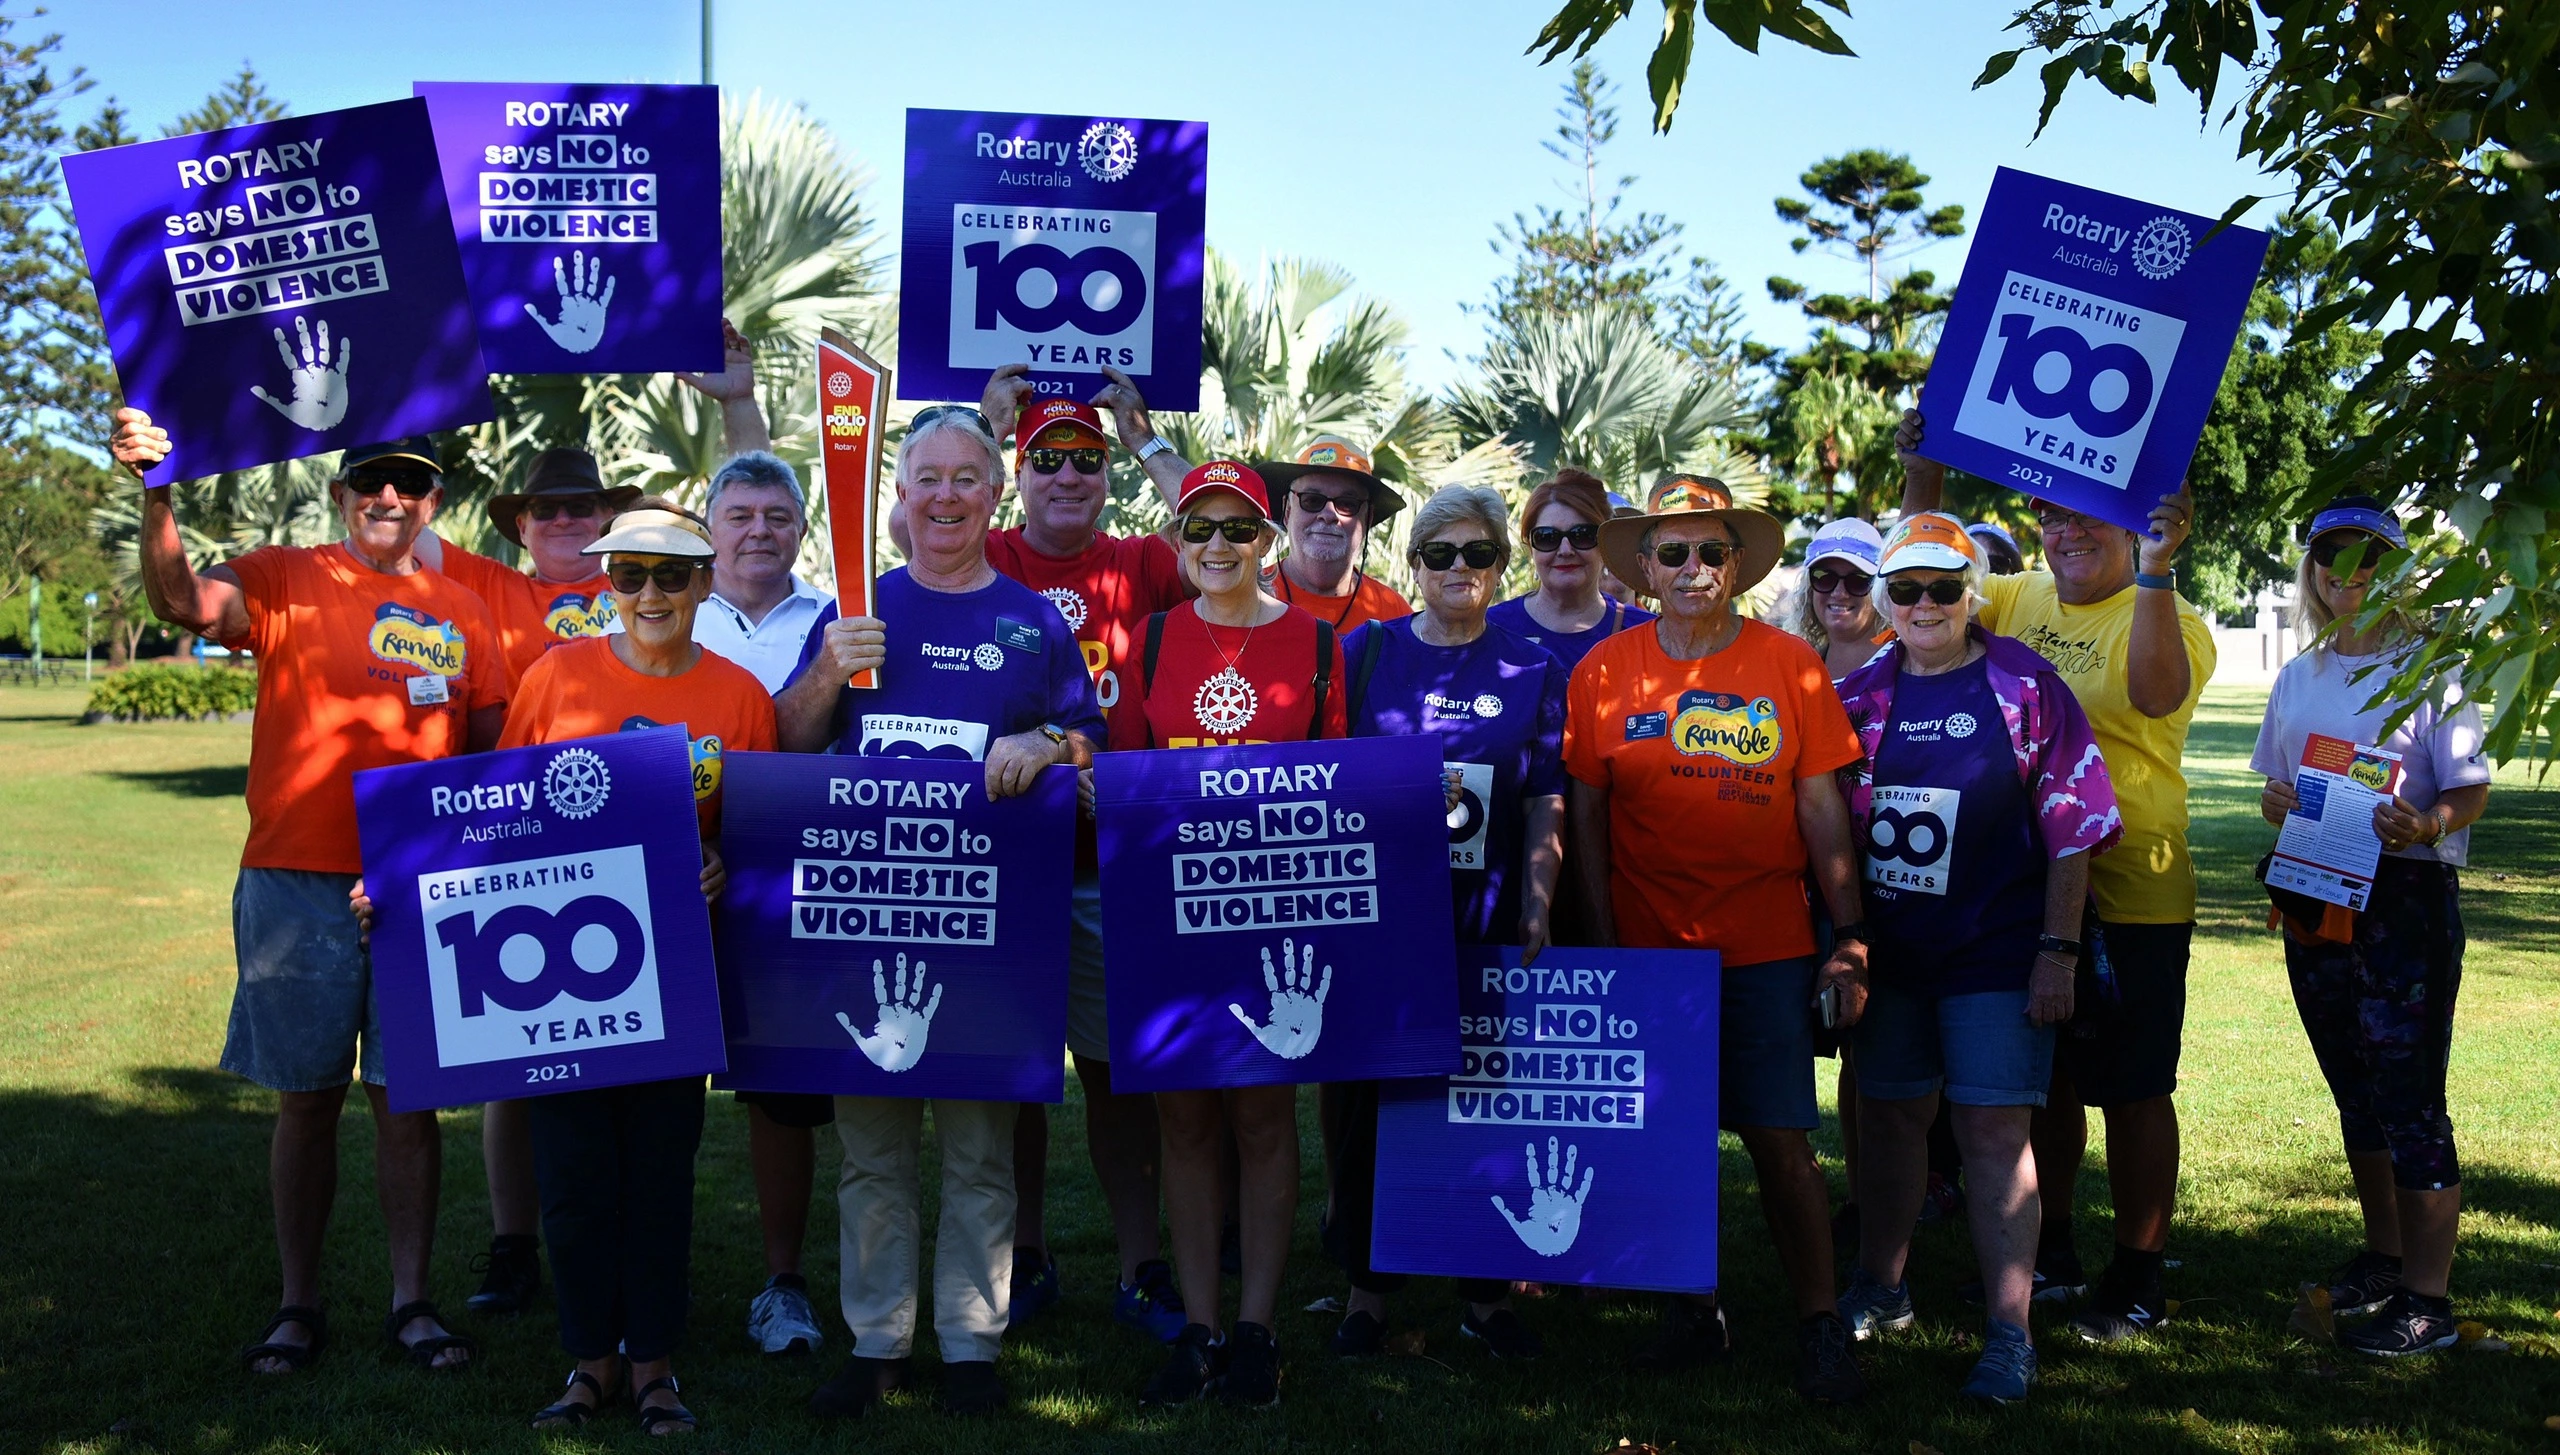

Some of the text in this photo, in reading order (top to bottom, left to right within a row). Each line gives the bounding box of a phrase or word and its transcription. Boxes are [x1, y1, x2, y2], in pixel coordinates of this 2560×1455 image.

[505, 101, 629, 128] ROTARY
[484, 138, 649, 169] says NO to
[976, 132, 1071, 166] Rotary
[176, 138, 324, 189] ROTARY
[488, 178, 650, 202] DOMESTIC
[998, 169, 1072, 188] Australia
[165, 180, 360, 237] says NO to
[488, 214, 651, 238] VIOLENCE
[961, 212, 1112, 234] CELEBRATING
[2042, 203, 2130, 254] Rotary
[175, 222, 371, 278] DOMESTIC
[2052, 245, 2119, 276] Australia
[182, 261, 381, 320] VIOLENCE
[963, 240, 1147, 336] 100
[2008, 281, 2141, 332] CELEBRATING
[1027, 343, 1135, 367] YEARS
[1986, 313, 2154, 439] 100
[826, 415, 866, 426] POLIO
[833, 405, 861, 416] END
[1043, 405, 1077, 415] POLIO
[830, 425, 862, 436] NOW
[834, 443, 857, 452] Rotary
[2023, 427, 2117, 474] YEARS
[1204, 469, 1240, 479] POLIO
[2008, 463, 2053, 488] 2021
[390, 607, 412, 618] Rotary
[382, 632, 459, 669] Ramble
[921, 642, 971, 660] Rotary
[931, 660, 970, 671] Australia
[1424, 693, 1471, 711] Rotary
[1433, 710, 1470, 720] Australia
[1691, 697, 1714, 705] Rotary
[1756, 700, 1771, 713] R
[864, 719, 959, 736] CELEBRATING
[1899, 717, 1943, 733] Rotary
[1906, 733, 1941, 742] Australia
[1685, 724, 1771, 755] Ramble
[1199, 763, 1339, 797] ROTARY
[1670, 765, 1775, 785] VOLUNTEER
[2352, 768, 2385, 786] Ramble
[431, 781, 536, 816] Rotary
[828, 777, 971, 809] ROTARY
[1872, 791, 1931, 802] EBRATING
[461, 817, 542, 844] Australia
[802, 822, 992, 856] says NO to
[1178, 805, 1366, 847] says NO to
[1867, 806, 1948, 868] 00
[429, 862, 595, 900] CELEBRATING
[1181, 848, 1368, 886] DOMESTIC
[1875, 866, 1935, 888] YEARS
[801, 865, 991, 899] DOMESTIC
[1873, 887, 1897, 900] 2021
[799, 906, 988, 940] VIOLENCE
[1182, 890, 1371, 928] VIOLENCE
[435, 894, 646, 1019] 100
[1482, 967, 1617, 995] ROTARY
[521, 1011, 643, 1046] YEARS
[1459, 1008, 1638, 1042] says NO to
[526, 1062, 581, 1083] 2021
[1457, 1051, 1638, 1083] DOMESTIC
[1455, 1092, 1637, 1124] VIOLENCE
